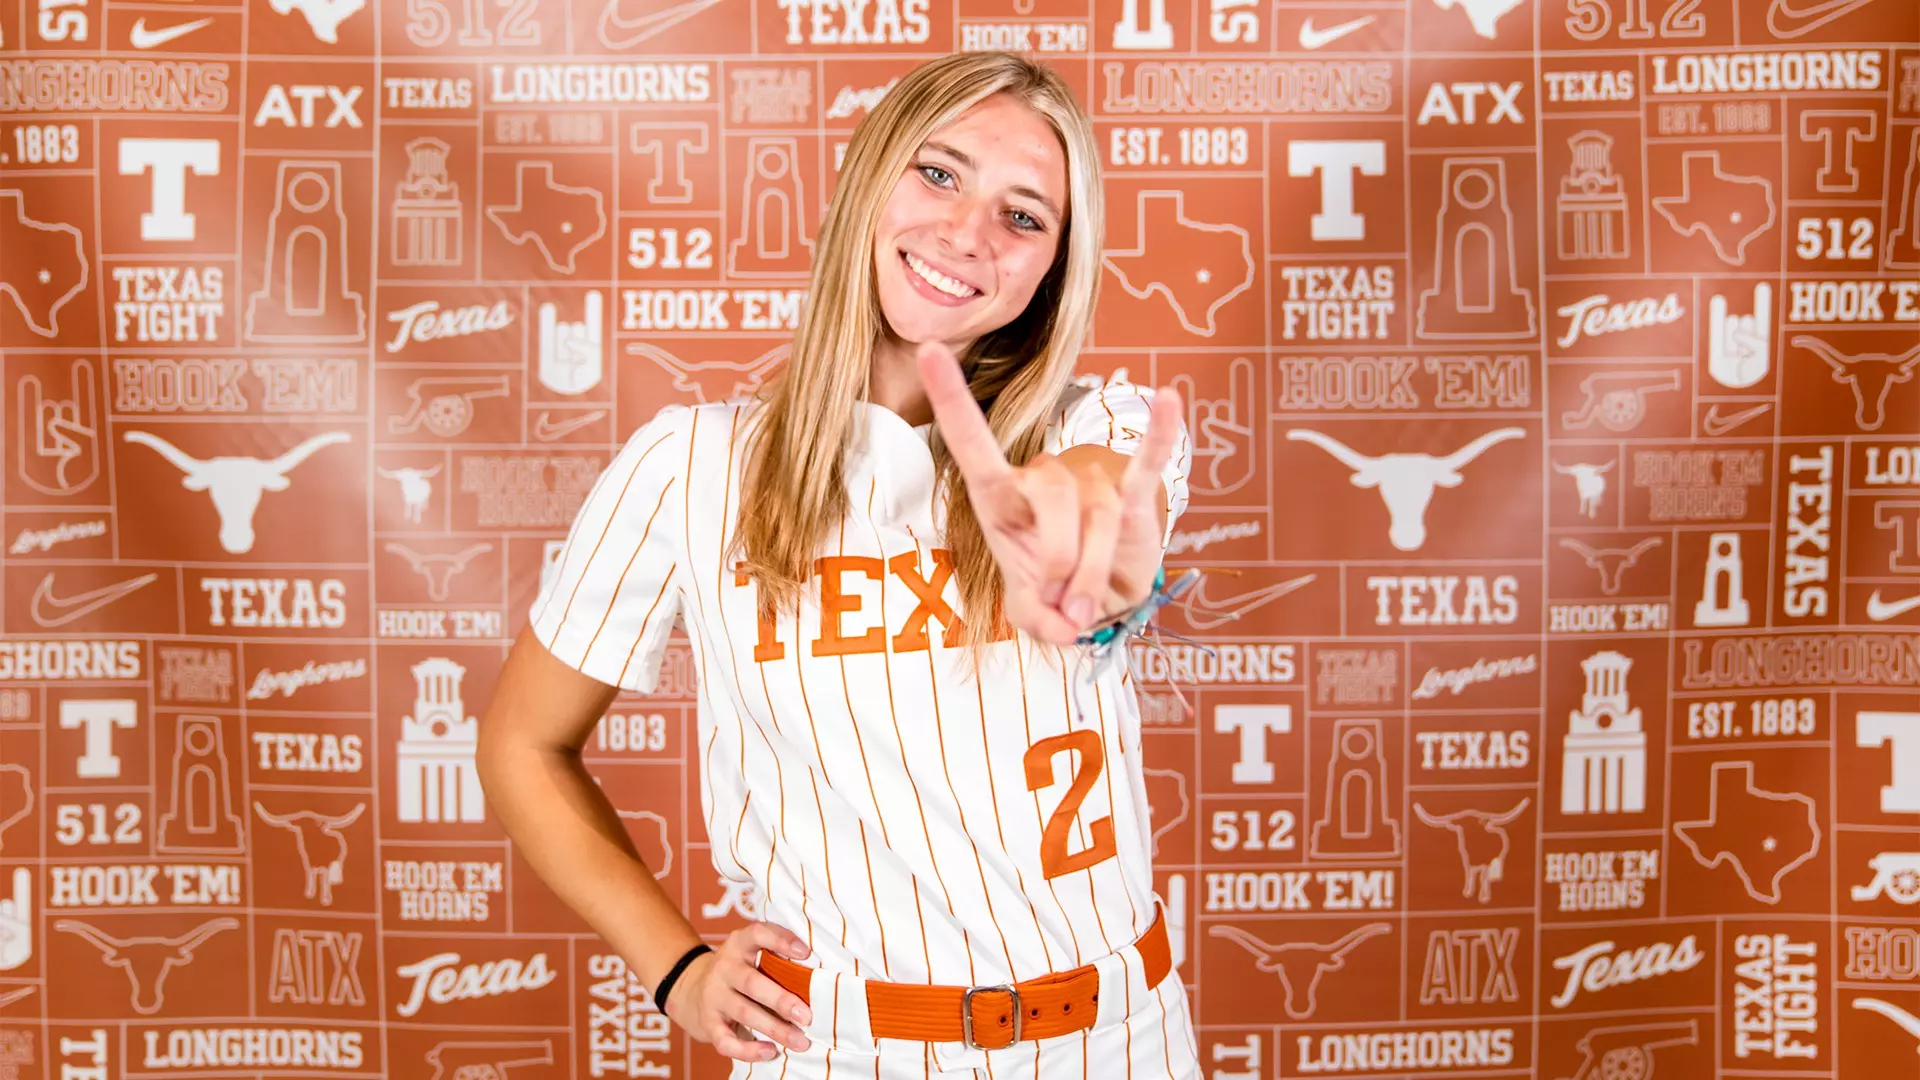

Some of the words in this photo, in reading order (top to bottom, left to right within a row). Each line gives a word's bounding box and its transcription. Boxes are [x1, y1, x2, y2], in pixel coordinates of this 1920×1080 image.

[777, 0, 931, 45] TEXAS
[961, 24, 1033, 52] HOOK
[1034, 24, 1088, 51] 'EM!
[383, 77, 473, 109] TEXAS
[490, 65, 710, 102] LONGHORNS
[1103, 62, 1392, 112] LONGHORNS
[1543, 70, 1635, 102] TEXAS
[1652, 51, 1882, 93] LONGHORNS
[253, 84, 363, 128] ATX
[1417, 82, 1525, 125] ATX
[14, 125, 79, 163] 1883
[1110, 128, 1170, 165] EST.
[1179, 127, 1249, 165] 1883
[118, 138, 221, 241] T
[1287, 140, 1387, 240] T
[627, 227, 714, 270] 512
[1796, 217, 1875, 260] 512
[112, 266, 224, 301] TEXAS
[1281, 265, 1395, 299] TEXAS
[1789, 280, 1886, 322] HOOK
[113, 301, 224, 342] FIGHT
[384, 299, 516, 353] Texas
[622, 289, 730, 331] HOOK
[732, 289, 809, 330] 'EM
[1282, 300, 1395, 340] FIGHT
[1556, 292, 1685, 349] Texas
[113, 359, 248, 412] HOOK
[251, 359, 358, 412] 'EM!
[1279, 357, 1419, 410] HOOK
[1423, 355, 1531, 409] 'EM!
[1783, 445, 1834, 617] TEXAS
[200, 577, 347, 628] TEXAS
[734, 547, 1018, 664] TEX
[1366, 575, 1519, 626] TEXAS
[1549, 606, 1615, 633] HOOK
[1619, 603, 1668, 631] 'EM!
[377, 610, 446, 638] HOOK
[448, 610, 501, 638] 'EM!
[59, 699, 137, 778] T
[597, 714, 666, 752] 1883
[1688, 702, 1743, 738] EST.
[1750, 697, 1817, 736] 1883
[252, 731, 363, 773] TEXAS
[1214, 704, 1292, 784] T
[1416, 730, 1530, 769] TEXAS
[56, 803, 143, 846] 512
[1023, 728, 1118, 880] 2
[1210, 810, 1296, 851] 512
[50, 865, 160, 906] HOOK
[163, 865, 241, 905] 'EM!
[385, 860, 457, 891] HOOK
[1545, 851, 1616, 883] HOOK
[399, 891, 489, 922] HORNS
[1205, 871, 1311, 912] HOOK
[1315, 869, 1395, 910] 'EM!
[1559, 880, 1645, 912] HORNS
[269, 928, 366, 1005] ATX
[396, 953, 557, 1017] Texas
[1419, 928, 1520, 1005] ATX
[1550, 935, 1705, 1009] Texas
[588, 954, 627, 1078] TEXAS
[1734, 934, 1772, 1057] TEXAS
[1773, 934, 1817, 1058] FIGHT
[143, 1029, 363, 1067] LONGHORNS
[1297, 1029, 1513, 1072] LONGHORNS
